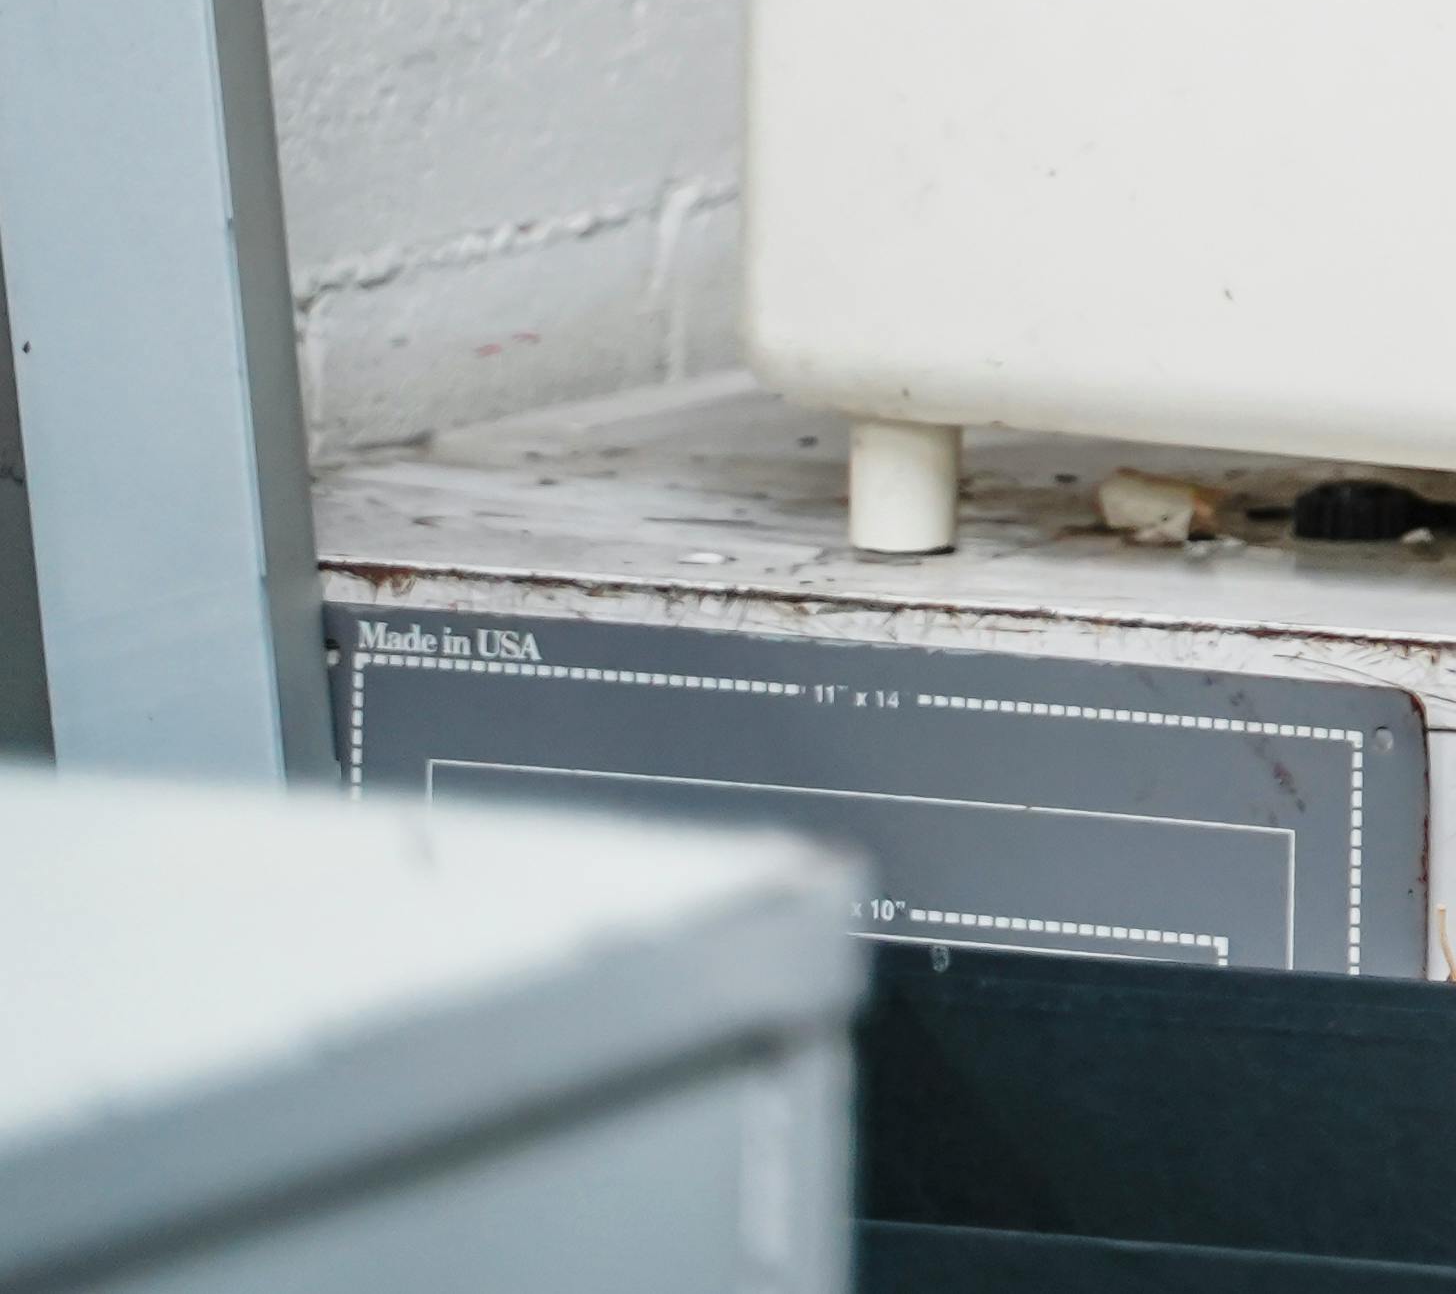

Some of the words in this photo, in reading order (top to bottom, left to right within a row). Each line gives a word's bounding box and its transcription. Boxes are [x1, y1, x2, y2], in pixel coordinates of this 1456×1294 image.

[357, 619, 439, 654] Made
[442, 626, 472, 657] in
[476, 627, 543, 661] USA
[856, 692, 868, 707] x
[870, 898, 906, 922] 10"
